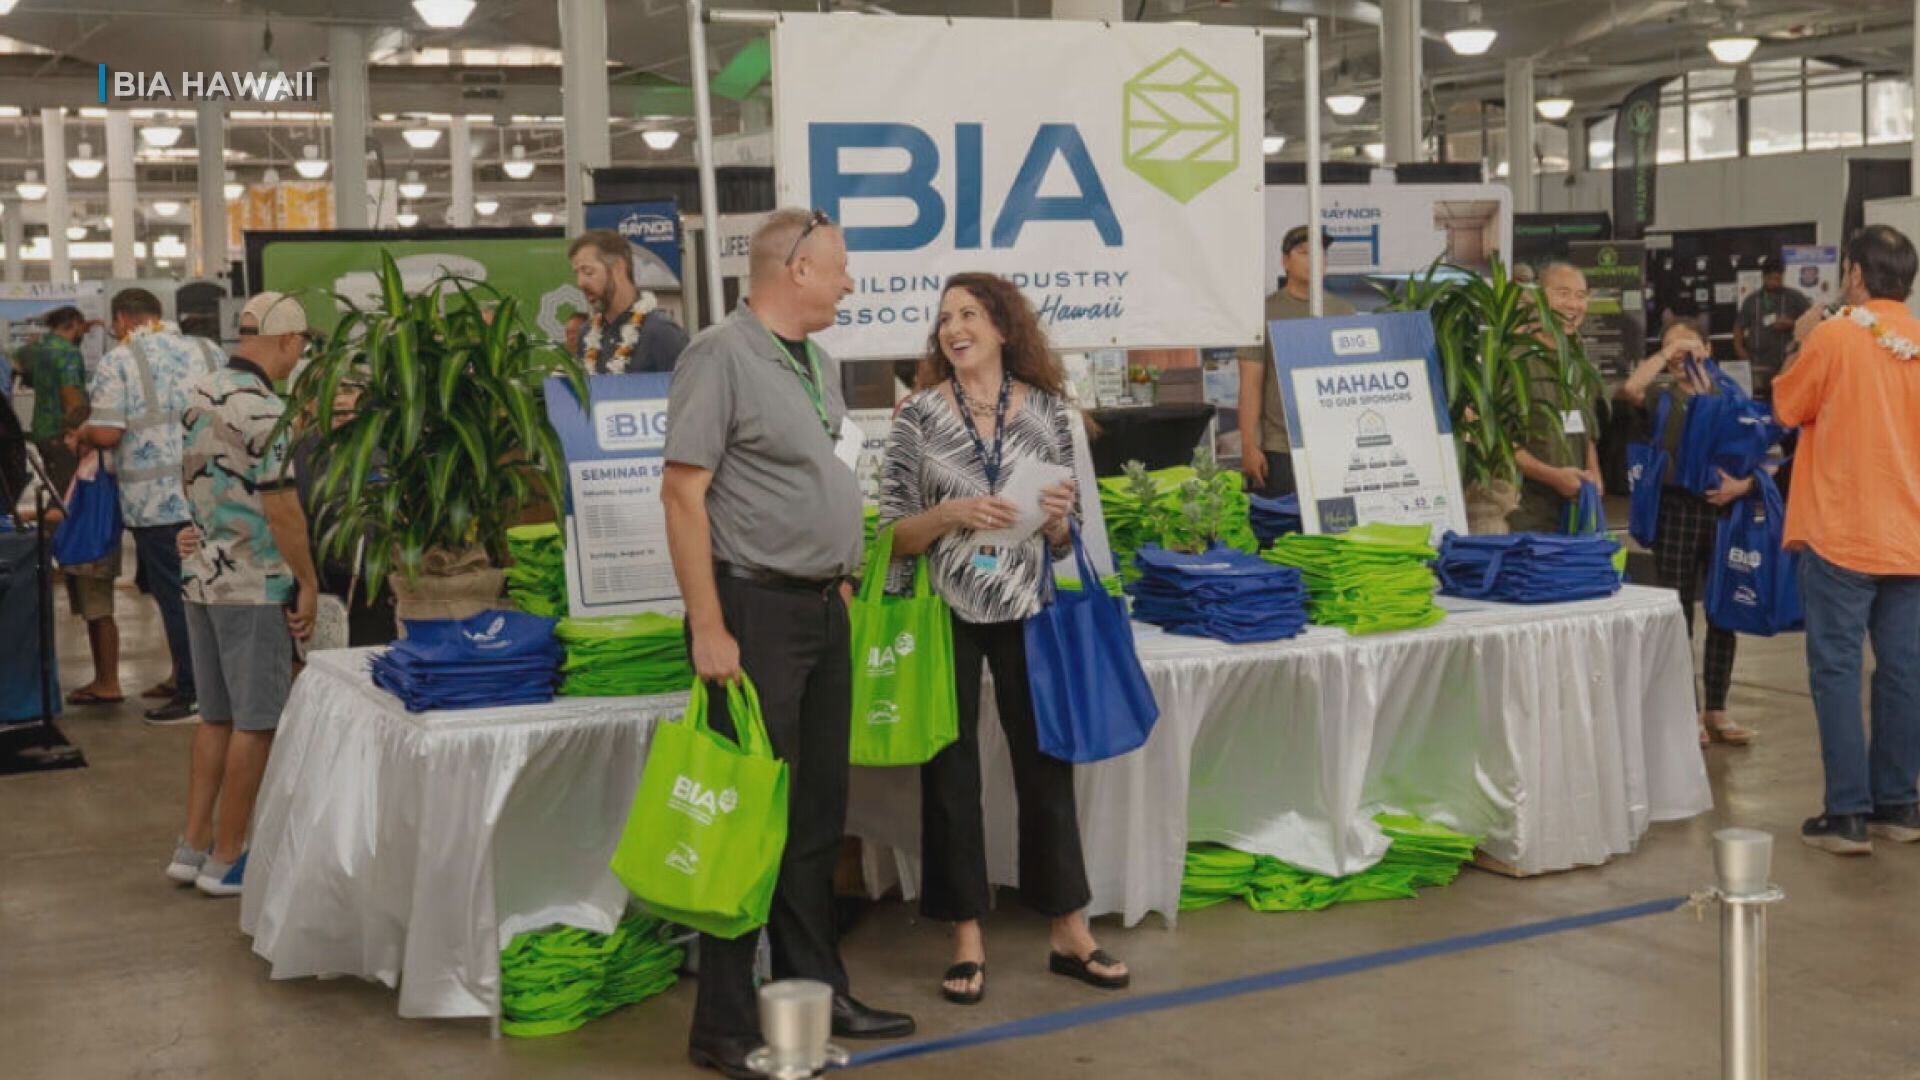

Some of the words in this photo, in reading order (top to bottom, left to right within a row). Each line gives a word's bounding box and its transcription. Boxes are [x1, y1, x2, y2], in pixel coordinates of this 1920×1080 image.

[807, 121, 1124, 252] BIA
[1013, 270, 1130, 289] DUSTRY
[1036, 294, 1125, 325] Hawaii
[1316, 371, 1409, 396] MAHALO
[581, 466, 648, 480] SEMINAR
[671, 775, 717, 816] BIA
